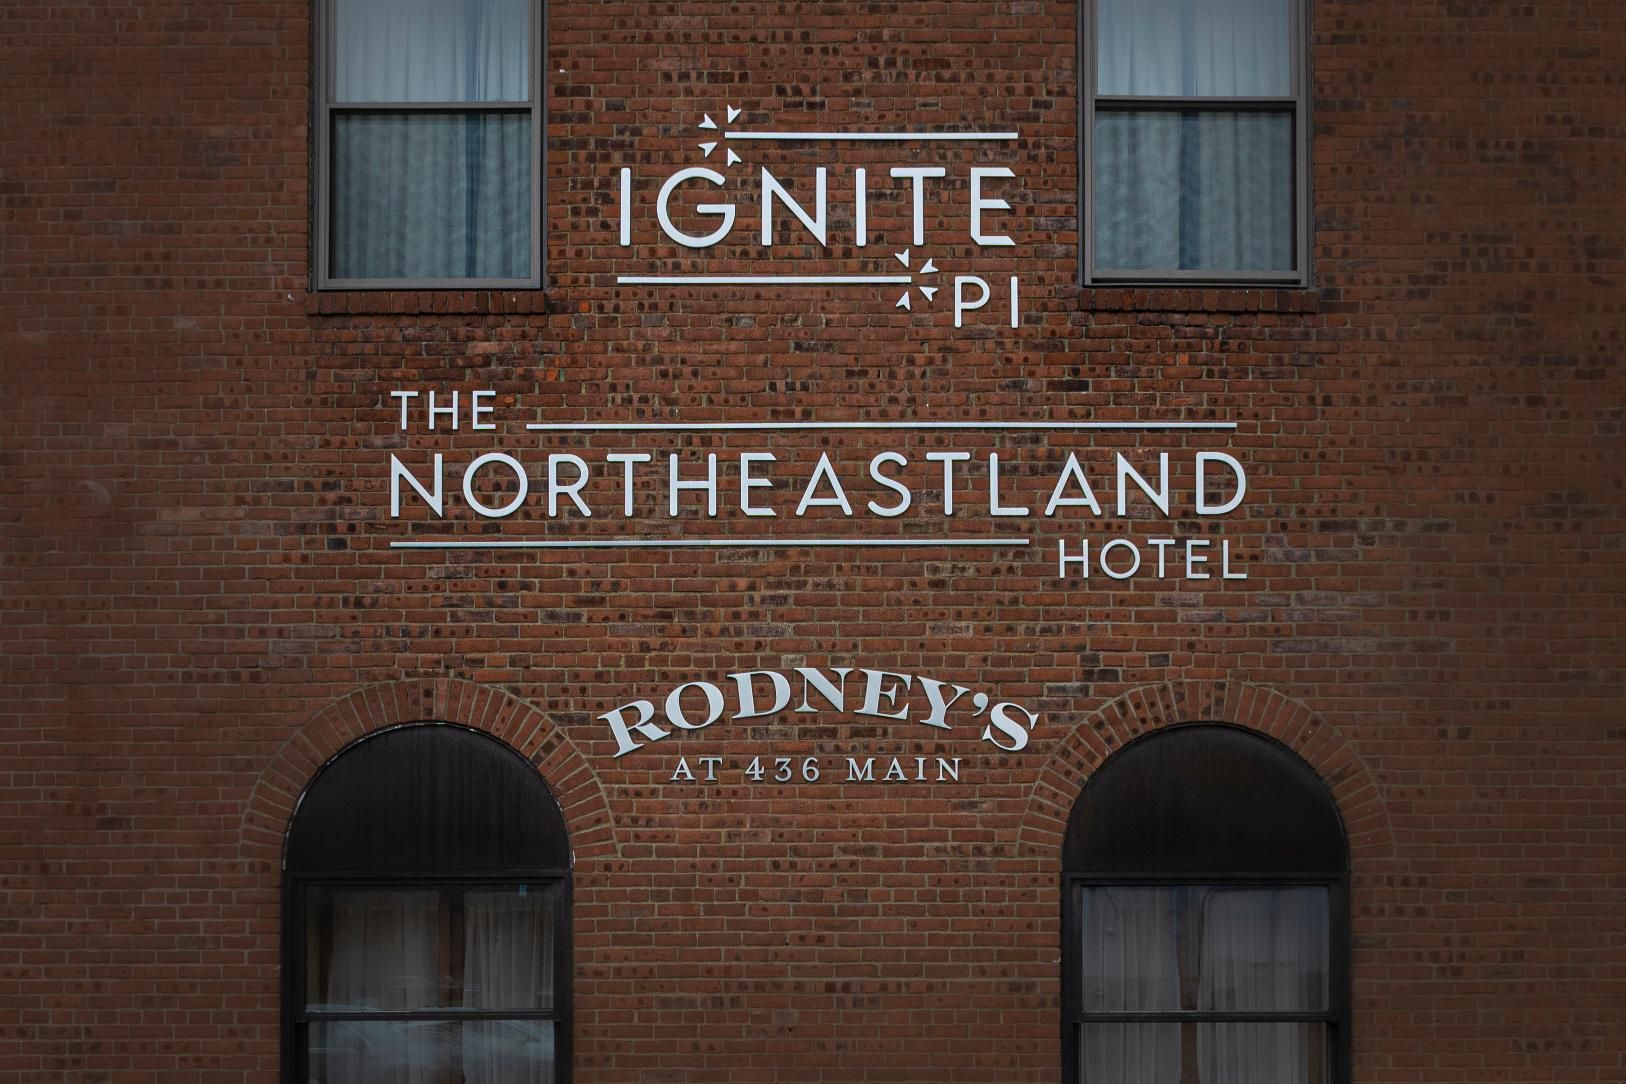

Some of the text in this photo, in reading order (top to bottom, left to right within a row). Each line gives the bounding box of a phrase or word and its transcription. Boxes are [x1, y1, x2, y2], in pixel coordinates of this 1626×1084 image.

[619, 165, 1017, 249] IGNITE
[953, 274, 1020, 330] PI
[390, 389, 498, 431] THE
[389, 450, 1248, 519] NORTHEASTLAND
[1057, 537, 1249, 580] HOTEL
[596, 666, 1040, 759] RODNEY'S
[670, 754, 963, 783] AT 436 MAIN
